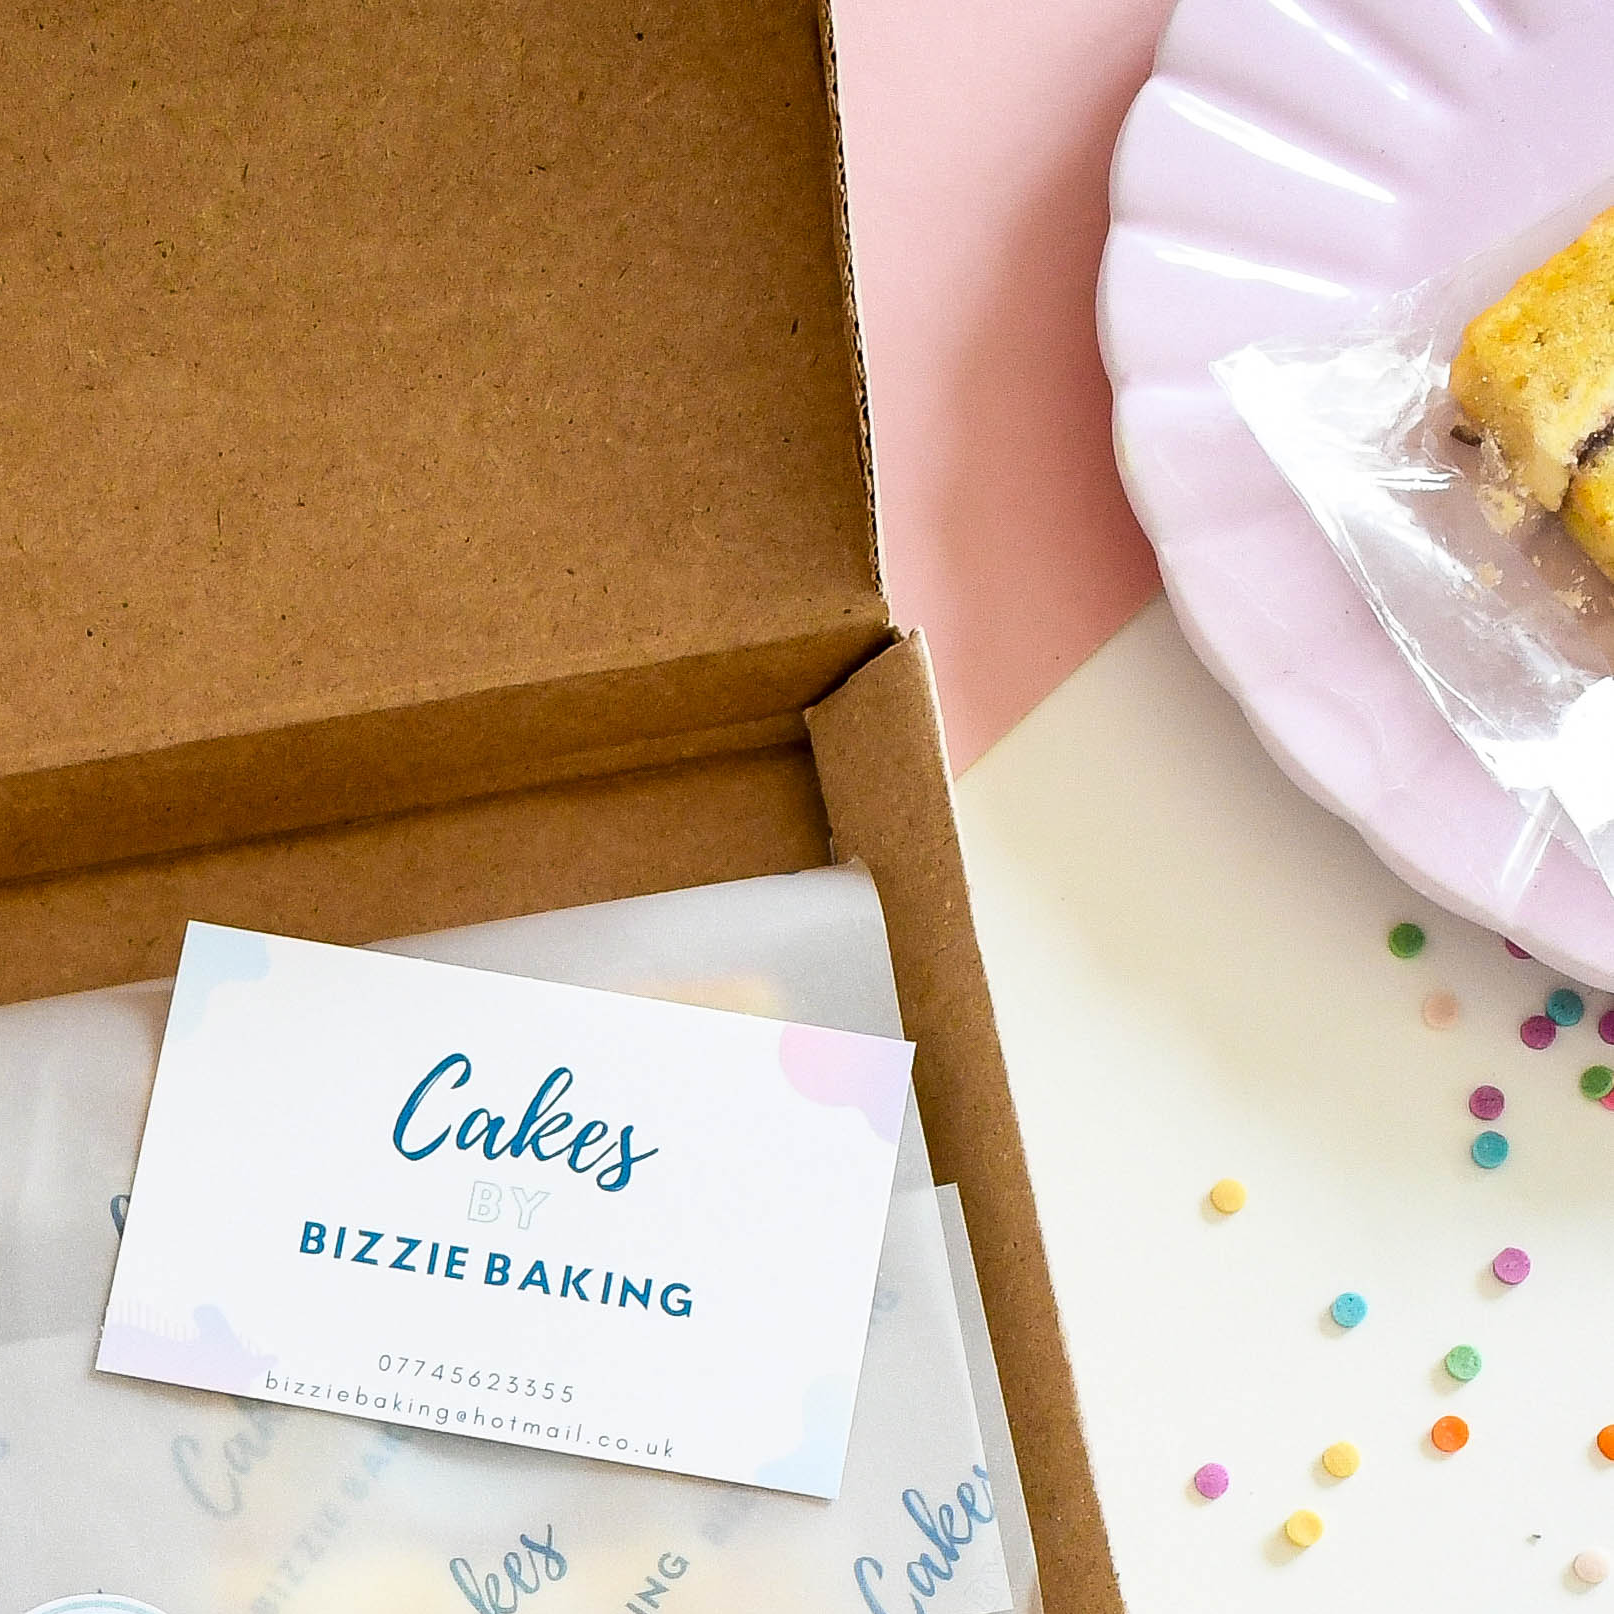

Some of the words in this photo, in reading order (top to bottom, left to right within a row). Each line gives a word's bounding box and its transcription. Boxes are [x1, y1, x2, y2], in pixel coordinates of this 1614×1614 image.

[393, 1053, 659, 1192] Cakes
[468, 1180, 551, 1230] BY
[300, 1221, 469, 1281] BIZZIE
[483, 1252, 695, 1319] BAKING
[265, 1370, 676, 1458] bizziebaking@hotmail.co.uk
[378, 1353, 575, 1404] 07745623355
